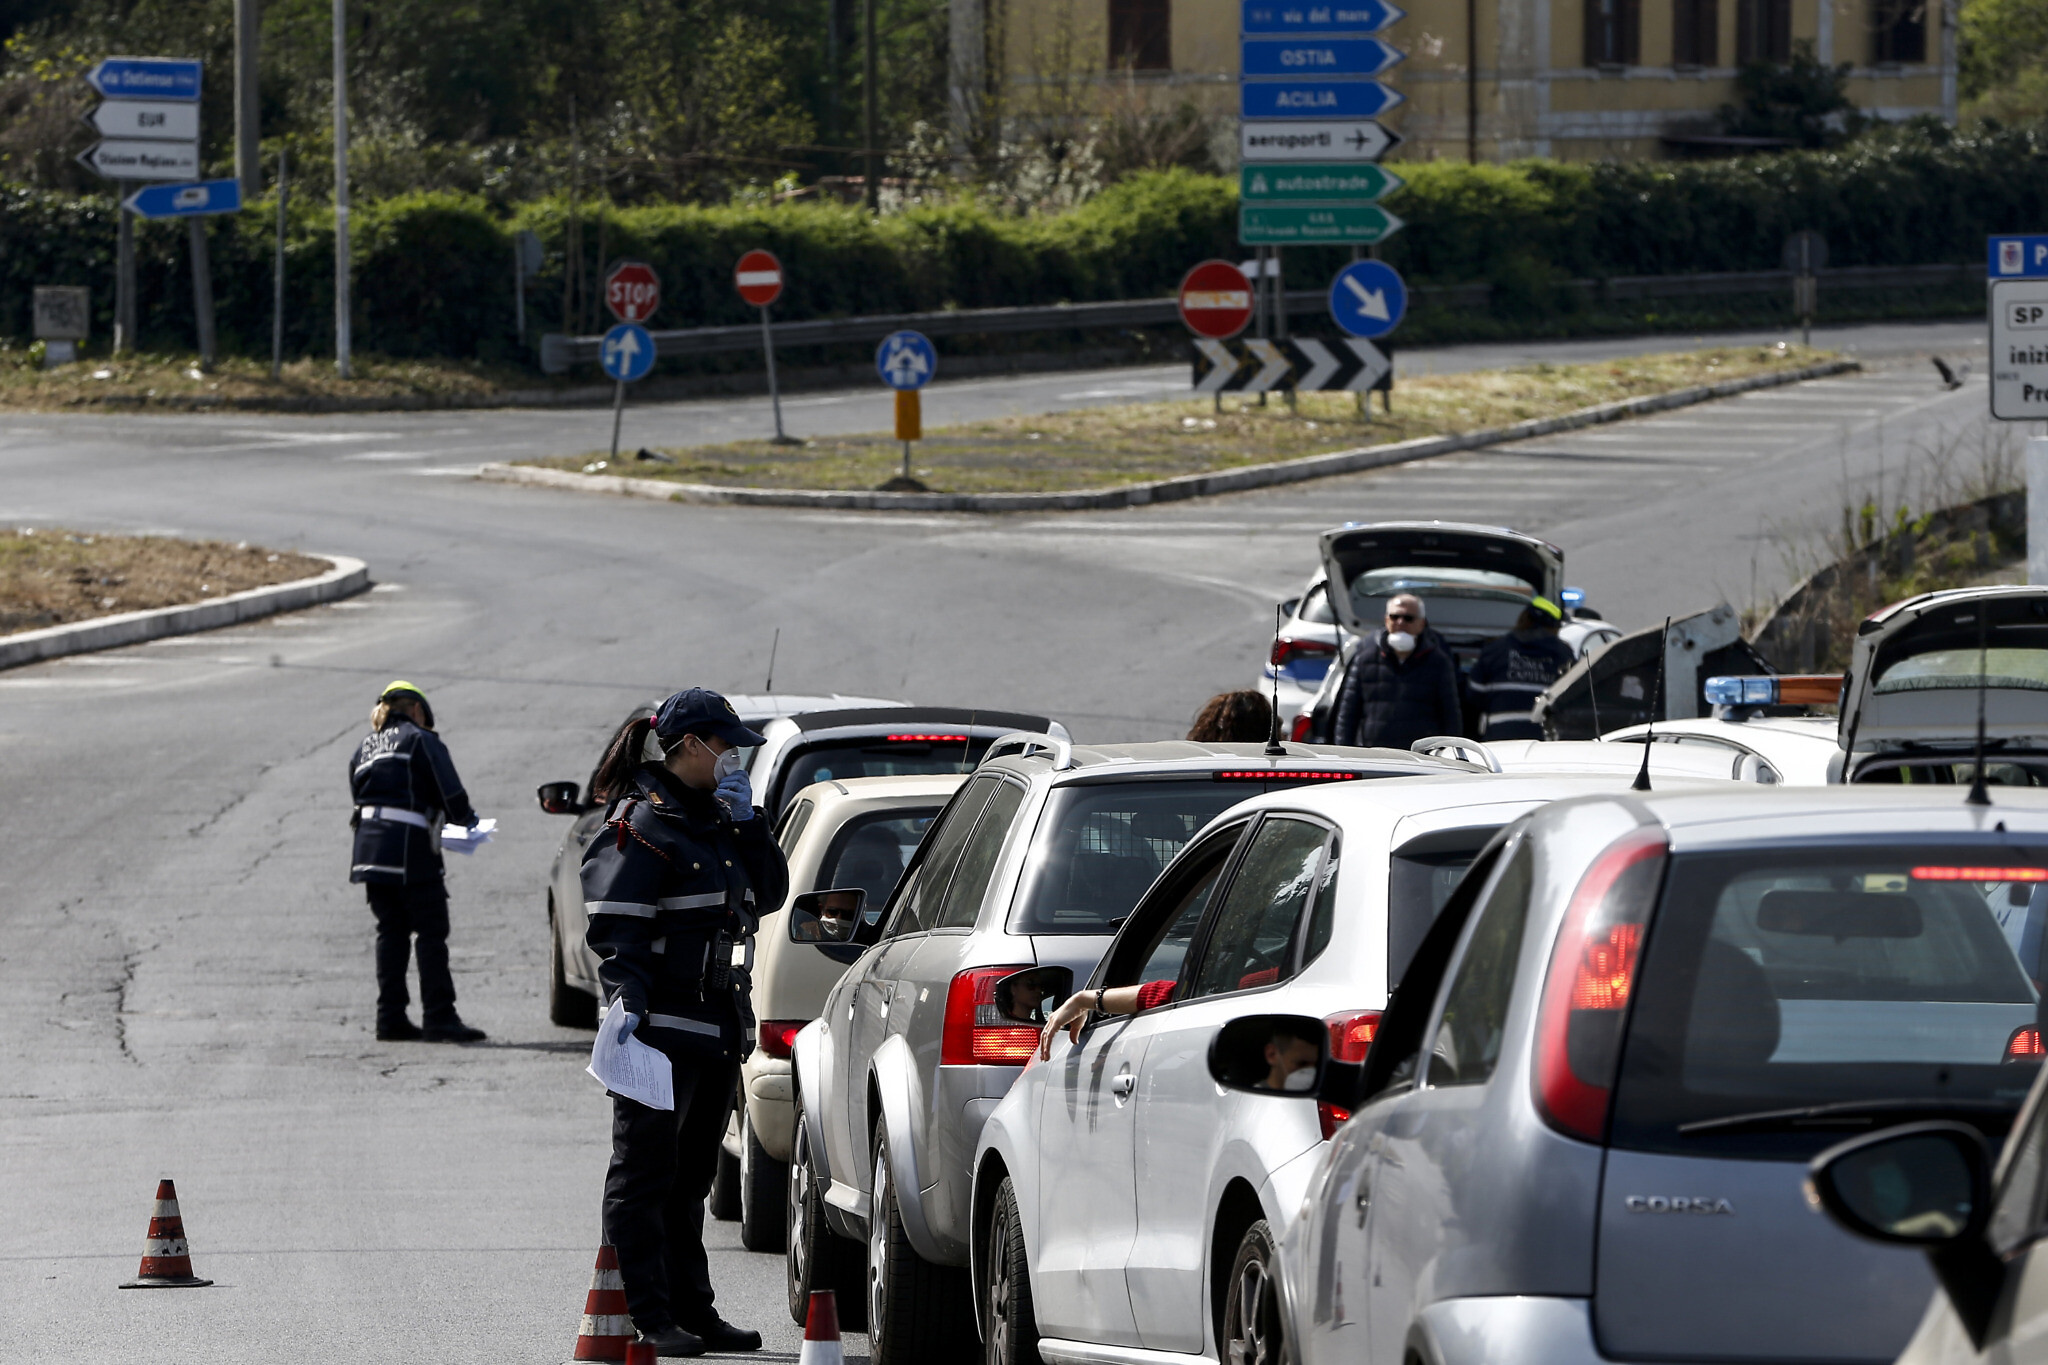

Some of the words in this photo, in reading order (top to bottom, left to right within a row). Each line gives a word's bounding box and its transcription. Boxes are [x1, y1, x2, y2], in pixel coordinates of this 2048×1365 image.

[1279, 49, 1337, 66] OSTIA
[1276, 90, 1338, 108] ACILIA
[1248, 131, 1332, 149] aeroporti
[1275, 173, 1370, 191] autostrade
[611, 280, 657, 305] STOP
[2015, 306, 2044, 324] SP
[1625, 1195, 1736, 1217] CORSA
